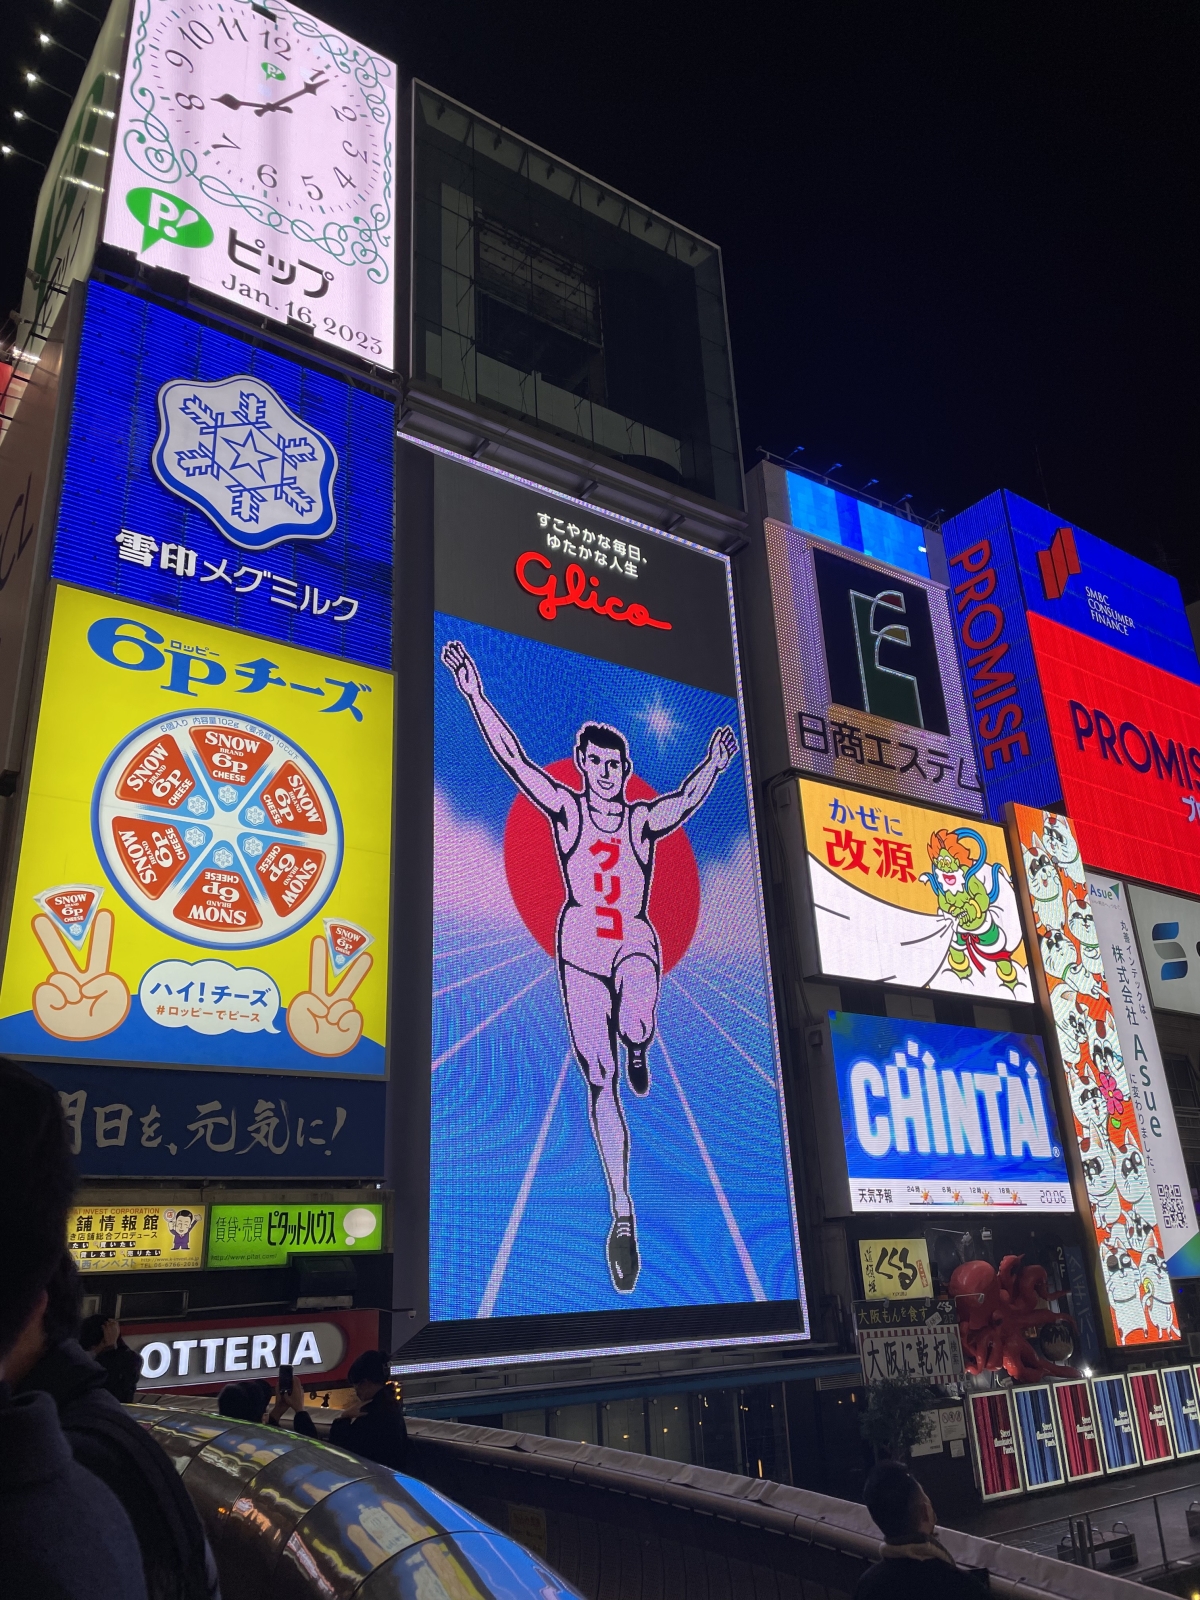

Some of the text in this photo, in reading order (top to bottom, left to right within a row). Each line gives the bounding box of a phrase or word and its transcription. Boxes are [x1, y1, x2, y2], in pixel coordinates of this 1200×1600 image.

[178, 20, 214, 50] 10
[217, 17, 248, 42] 11
[259, 30, 293, 61] 12
[165, 49, 194, 73] 9
[175, 92, 205, 111] 8
[331, 105, 357, 122] 2
[211, 133, 241, 152] 7
[342, 140, 368, 164] 3
[256, 164, 278, 189] 6
[301, 175, 323, 201] 5
[332, 165, 356, 189] 4
[148, 192, 200, 239] P!
[228, 227, 335, 298] ピップ
[221, 274, 383, 355] Jan. 16, 2023
[536, 511, 649, 564] すこやかな毎日、
[546, 533, 639, 579] ゆたかな人生
[115, 528, 359, 621] 雪印メグミルク
[1084, 586, 1110, 606] SMBC
[1087, 598, 1136, 629] CONSUMER
[1090, 609, 1130, 636] FINANCE
[170, 640, 220, 656] ロッピー
[950, 539, 1030, 771] PROMISE
[160, 717, 188, 733] 6個入り
[204, 731, 260, 754] SNOW
[219, 747, 244, 757] BRAND
[126, 742, 169, 791] SNOW
[148, 764, 167, 785] BRAND
[211, 754, 248, 774] 6P
[212, 769, 246, 783] CHEESE
[152, 769, 183, 798] 6P
[168, 778, 193, 806] CHEESE
[263, 794, 283, 825] CHEESE
[274, 787, 295, 823] 6P
[287, 774, 322, 824] SNOW
[289, 791, 302, 813] BRAND
[828, 797, 904, 837] かぜに
[142, 840, 157, 865] BRAND
[151, 831, 173, 868] 6P
[165, 827, 186, 861] CHEESE
[822, 826, 917, 884] 改源
[118, 831, 158, 884] SNOW
[257, 845, 281, 874] CHEESE
[269, 853, 296, 883] 6P
[204, 872, 240, 884] CHEESE
[281, 859, 318, 908] SNOW
[283, 866, 299, 886] BRAND
[588, 837, 624, 940] グリコ
[54, 894, 87, 905] SNOW
[202, 882, 240, 903] 6P
[206, 900, 232, 909] BRAND
[1090, 883, 1113, 900] Asue
[61, 907, 83, 916] 6P
[64, 915, 84, 923] CHEESE
[188, 905, 247, 925] SNOW
[335, 927, 361, 942] SNOW
[336, 938, 353, 950] 6P
[1111, 943, 1162, 1138] 株式会社 Asue
[850, 1045, 1053, 1157] CHINTAI
[1129, 1073, 1157, 1174] に変わりました。
[858, 1188, 894, 1204] 天気予報
[76, 1215, 160, 1232] 舗情報館
[267, 1210, 336, 1246] ピタットハウス
[875, 1247, 918, 1291] くくる
[858, 1305, 928, 1325] 大阪もんを食す
[867, 1335, 949, 1379] 大阪に乾杯
